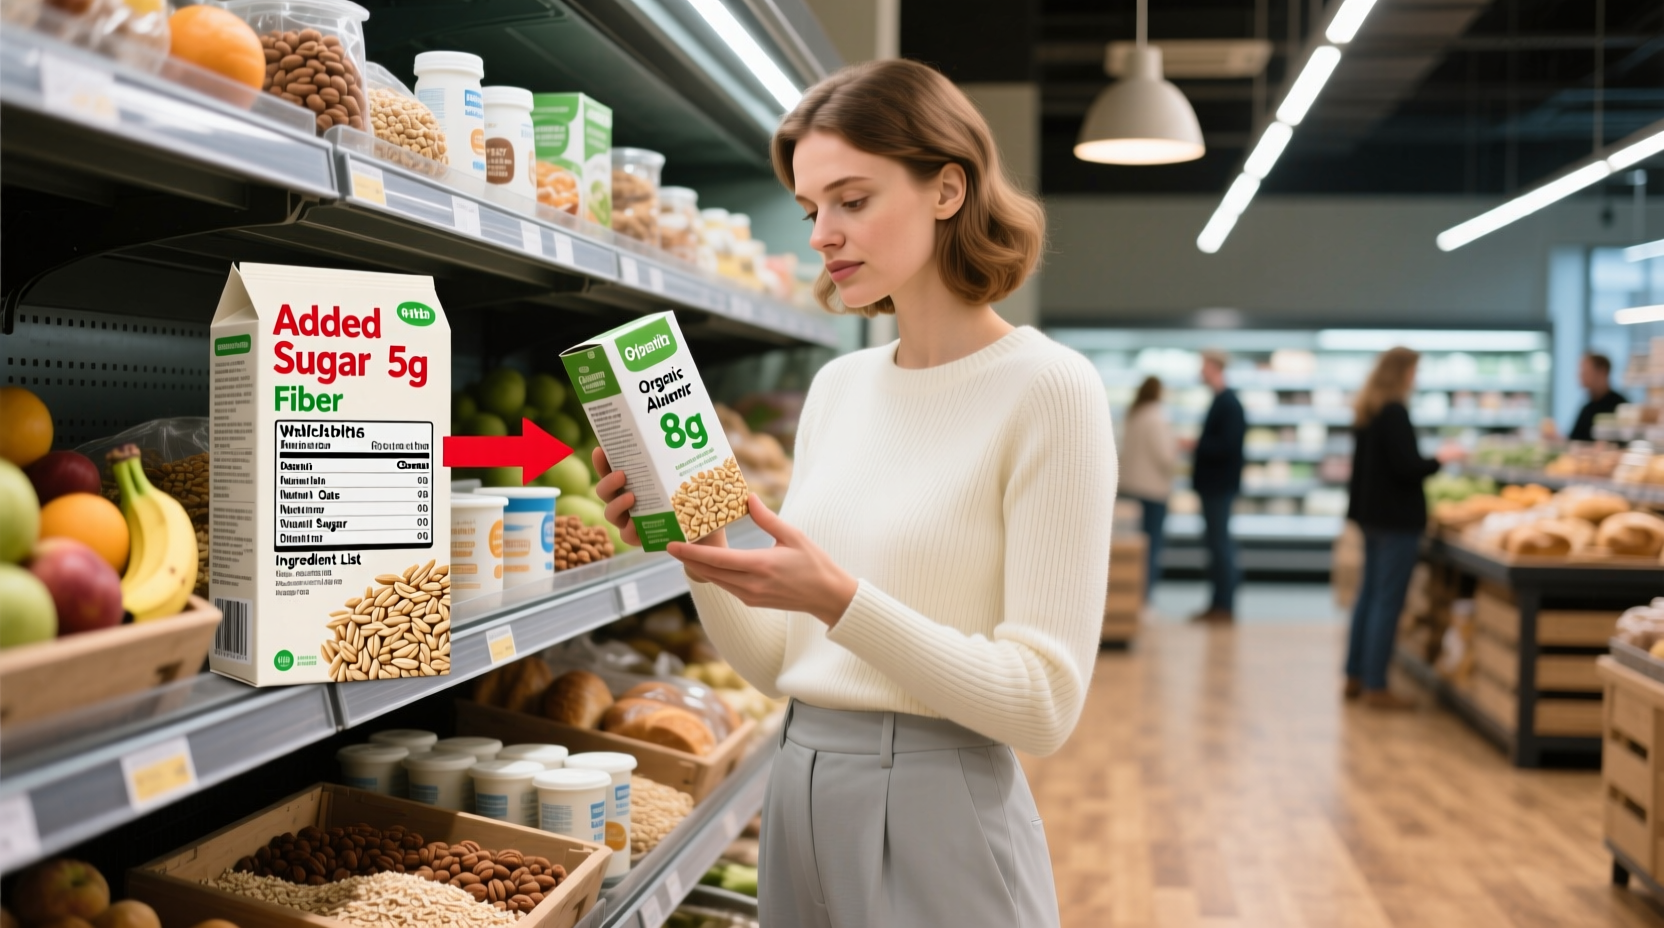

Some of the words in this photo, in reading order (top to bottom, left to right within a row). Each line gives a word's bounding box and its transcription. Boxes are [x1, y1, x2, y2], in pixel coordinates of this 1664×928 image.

[273, 304, 381, 338] Added
[273, 341, 371, 385] Sugar
[387, 345, 428, 388] 5g
[274, 385, 344, 412] Fiber
[660, 412, 708, 450] 8g
